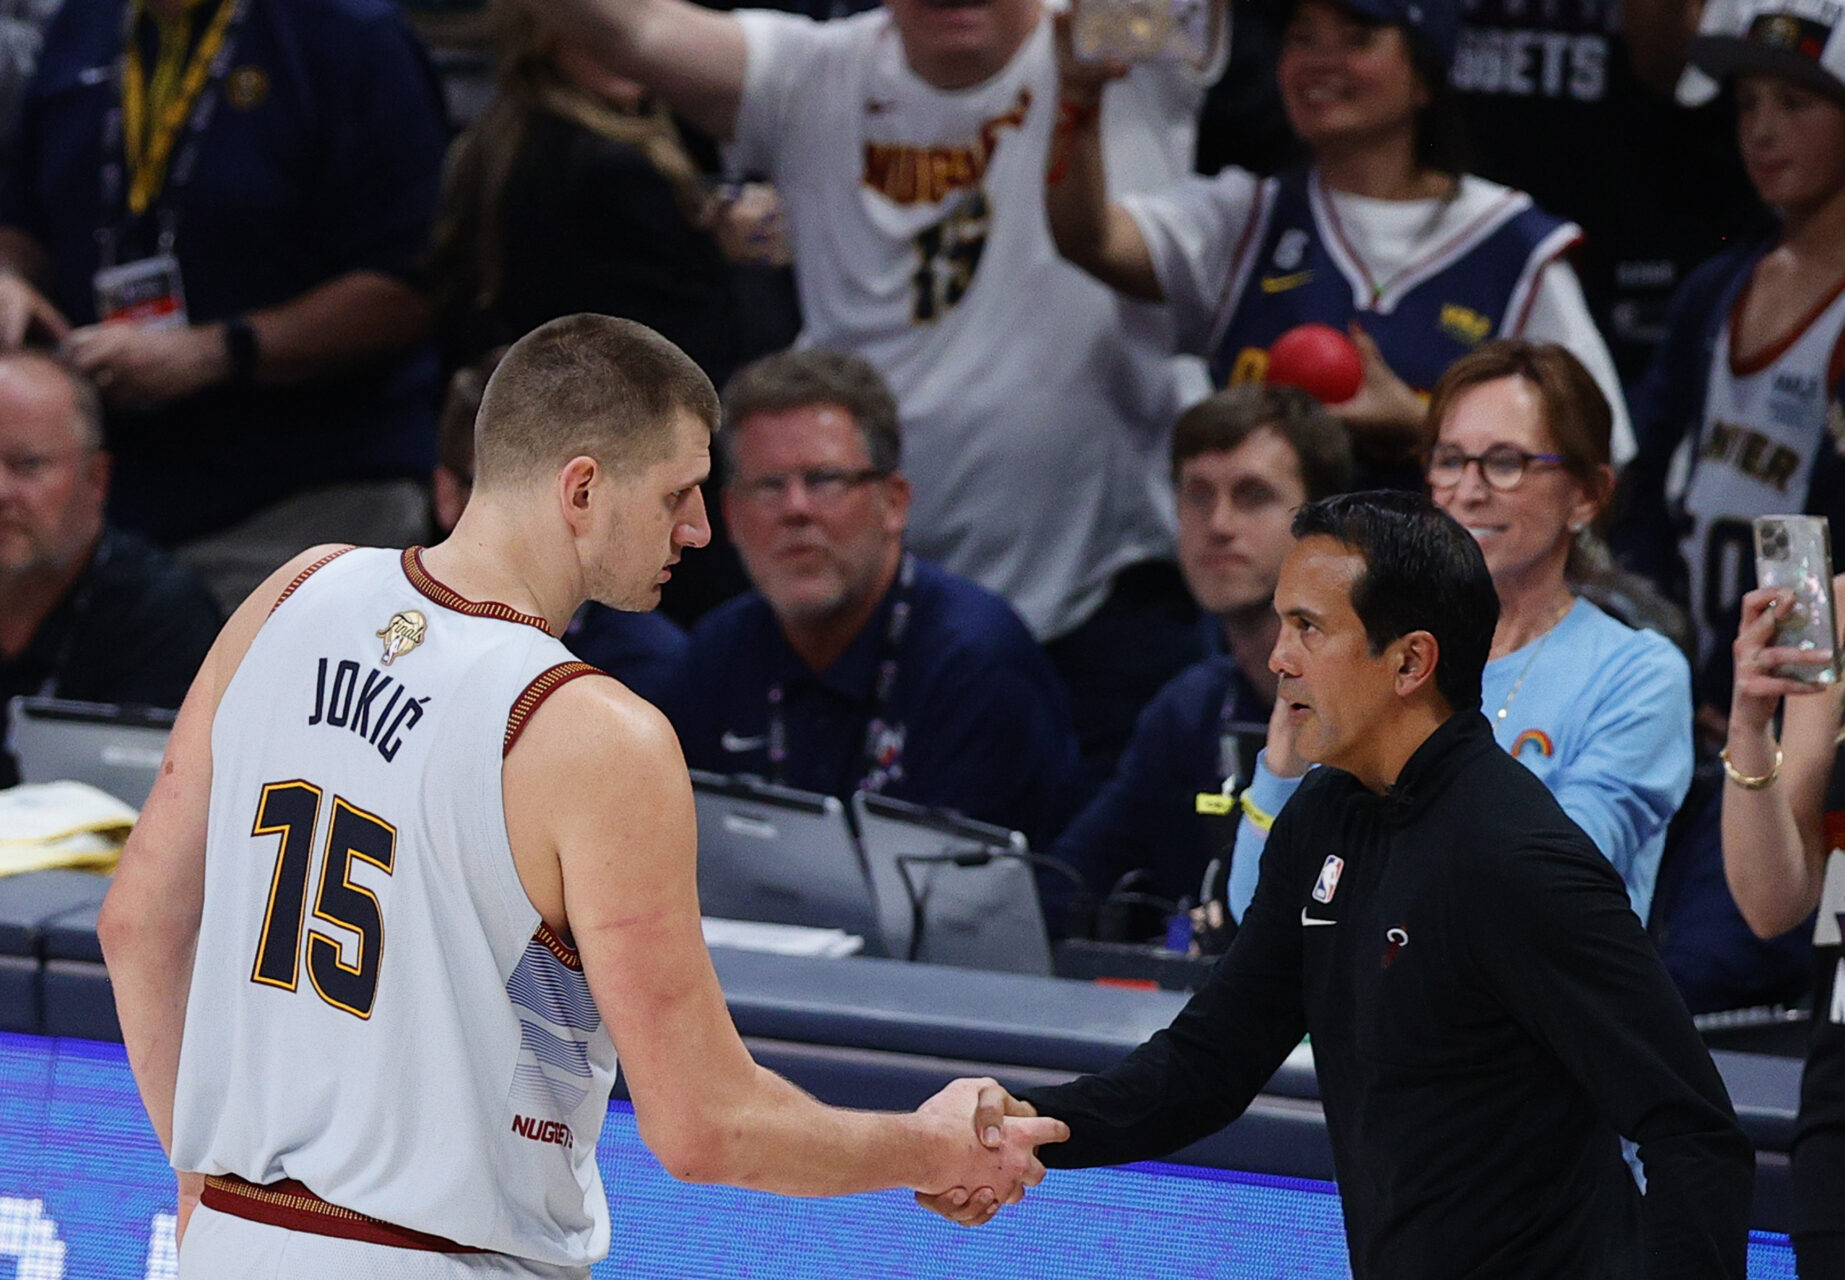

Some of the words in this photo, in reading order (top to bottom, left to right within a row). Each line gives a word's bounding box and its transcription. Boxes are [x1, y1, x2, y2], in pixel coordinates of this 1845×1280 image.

[378, 614, 424, 644] Finals
[308, 657, 432, 763] JOKIĆ
[251, 778, 397, 1021] 15
[512, 1114, 574, 1149] NUGET
